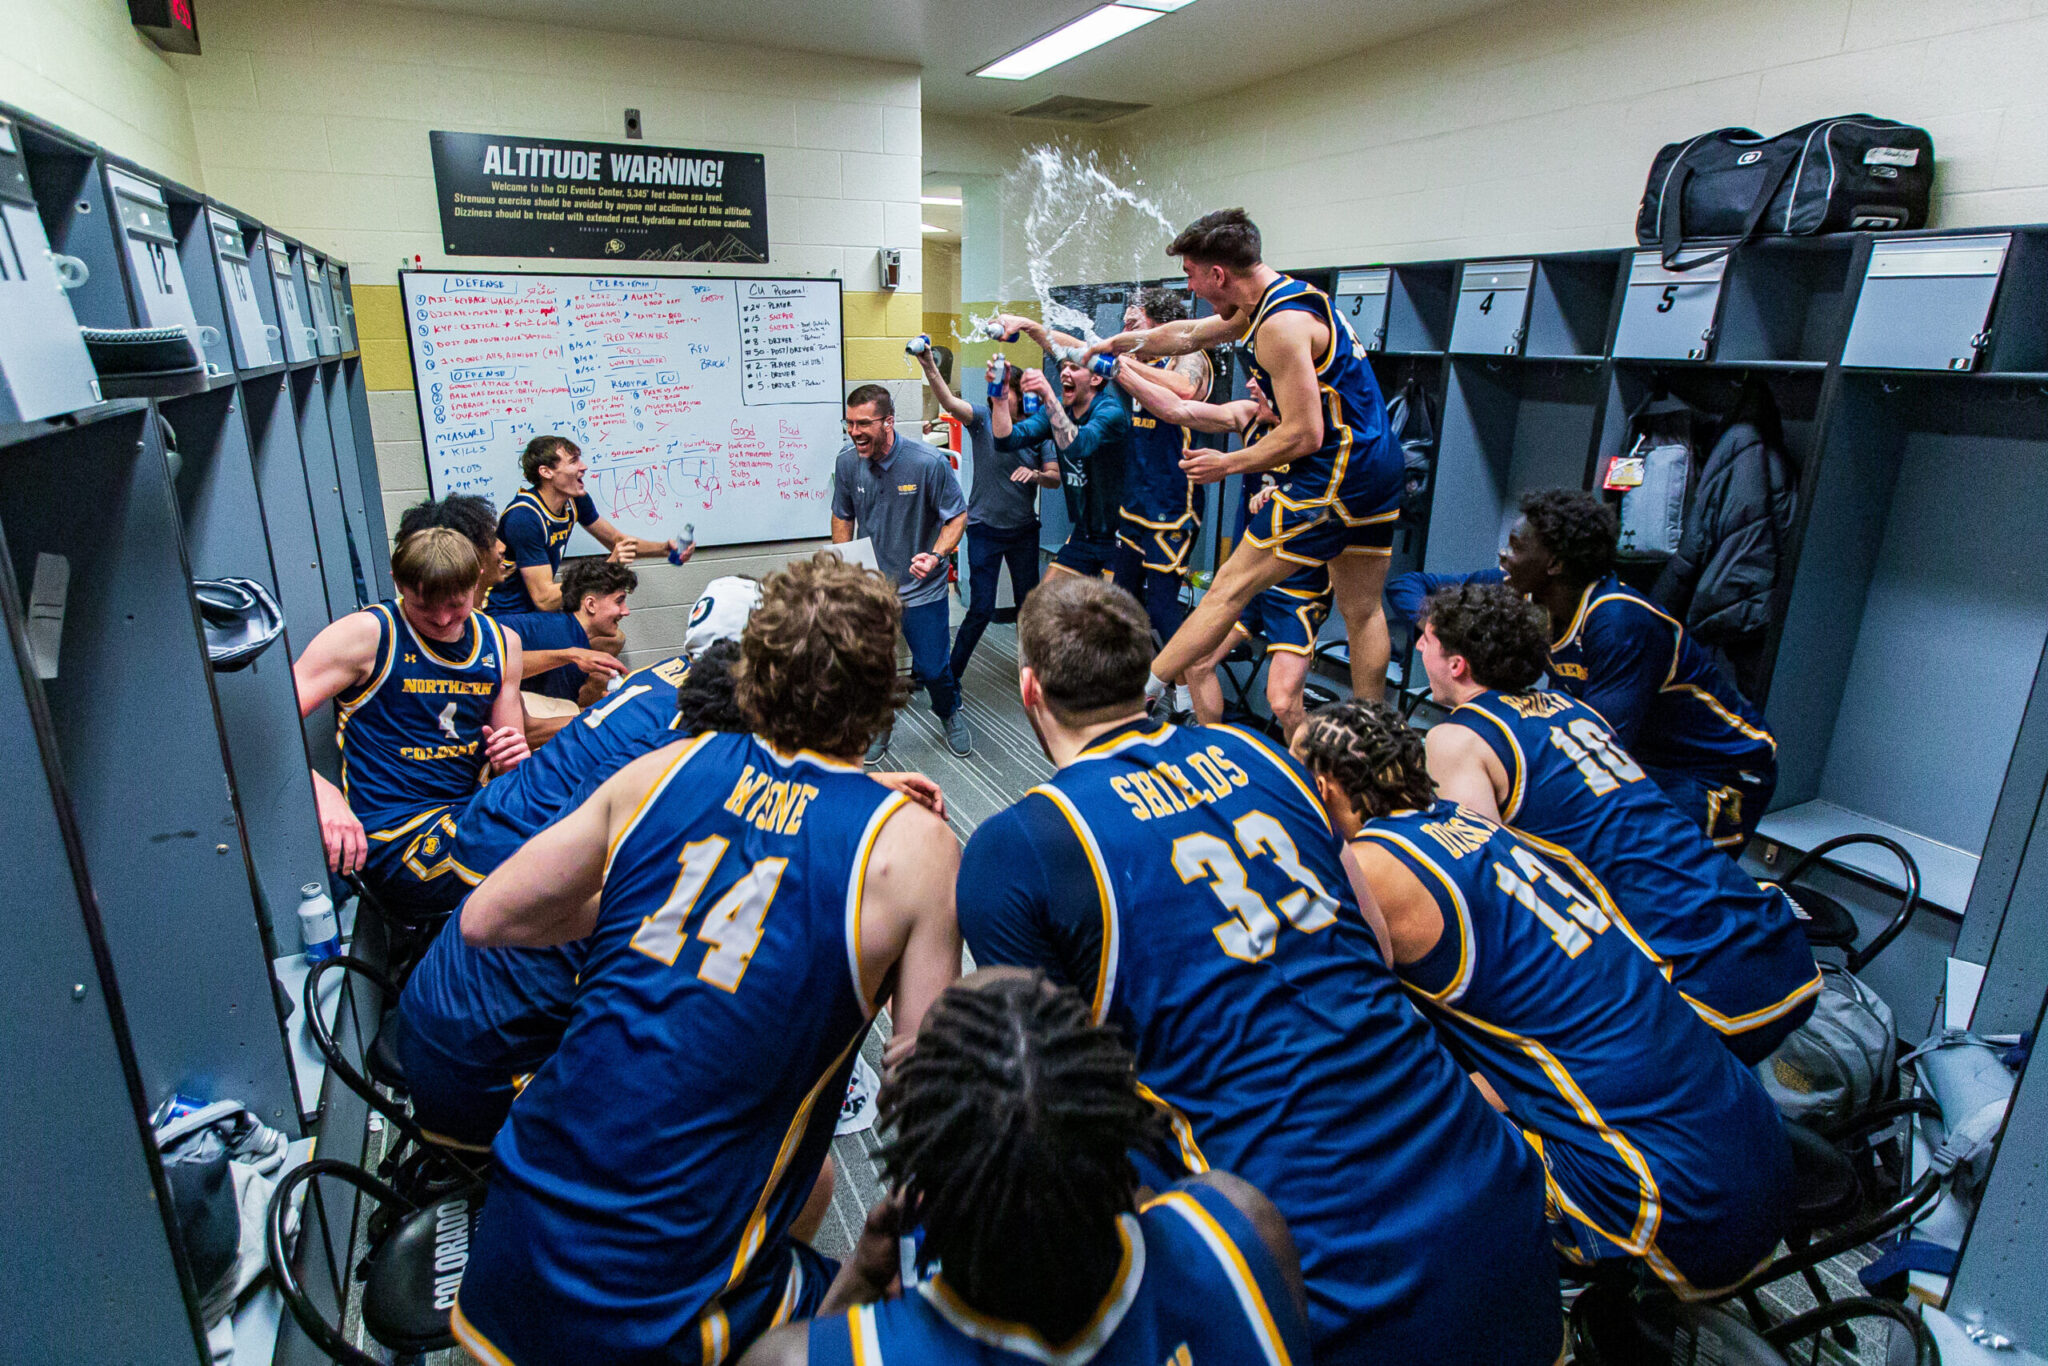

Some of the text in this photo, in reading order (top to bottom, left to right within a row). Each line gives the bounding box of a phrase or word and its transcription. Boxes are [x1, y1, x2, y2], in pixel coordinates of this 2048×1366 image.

[483, 145, 725, 188] ALTITUDE WARNING!
[491, 181, 528, 192] Welcome
[530, 183, 539, 193] to
[541, 184, 554, 194] the
[556, 184, 568, 194] CU
[570, 185, 596, 196] Events
[651, 190, 666, 199] feet
[668, 190, 689, 200] above
[690, 192, 704, 201] sea
[705, 192, 723, 202] level.
[454, 193, 752, 216] Strenuous exercise should be avoided by anyone not acclimated to this altitude.
[454, 207, 493, 218] Dizziness
[495, 208, 522, 219] should
[523, 209, 534, 219] be
[536, 210, 565, 221] treated
[566, 211, 584, 222] with
[586, 212, 620, 223] extended
[642, 215, 676, 227] hydration
[677, 216, 691, 226] and
[693, 217, 722, 227] extreme
[723, 218, 751, 228] caution.
[146, 243, 173, 294] 12
[455, 279, 504, 289] DEFENSE
[749, 282, 766, 296] CU
[767, 300, 793, 310] PLAYER
[1351, 295, 1363, 316] 3
[1479, 291, 1496, 315] 4
[1657, 286, 1679, 312] 5
[768, 337, 793, 345] DRIVER
[453, 370, 506, 381] OFFENSE
[659, 373, 675, 385] CU
[770, 370, 797, 379] DRIVER
[771, 380, 797, 389] DRIVER
[571, 385, 593, 395] UNC
[435, 428, 487, 444] MEASURE
[779, 419, 800, 435] Bad
[451, 445, 487, 457] KILLS
[401, 678, 495, 696] NORTHERN
[582, 684, 653, 729] 1
[1549, 717, 1647, 798] 10
[1170, 808, 1342, 964] 33
[1492, 844, 1612, 960] 13
[628, 833, 790, 995] 14
[433, 1199, 470, 1311] COLORADO
